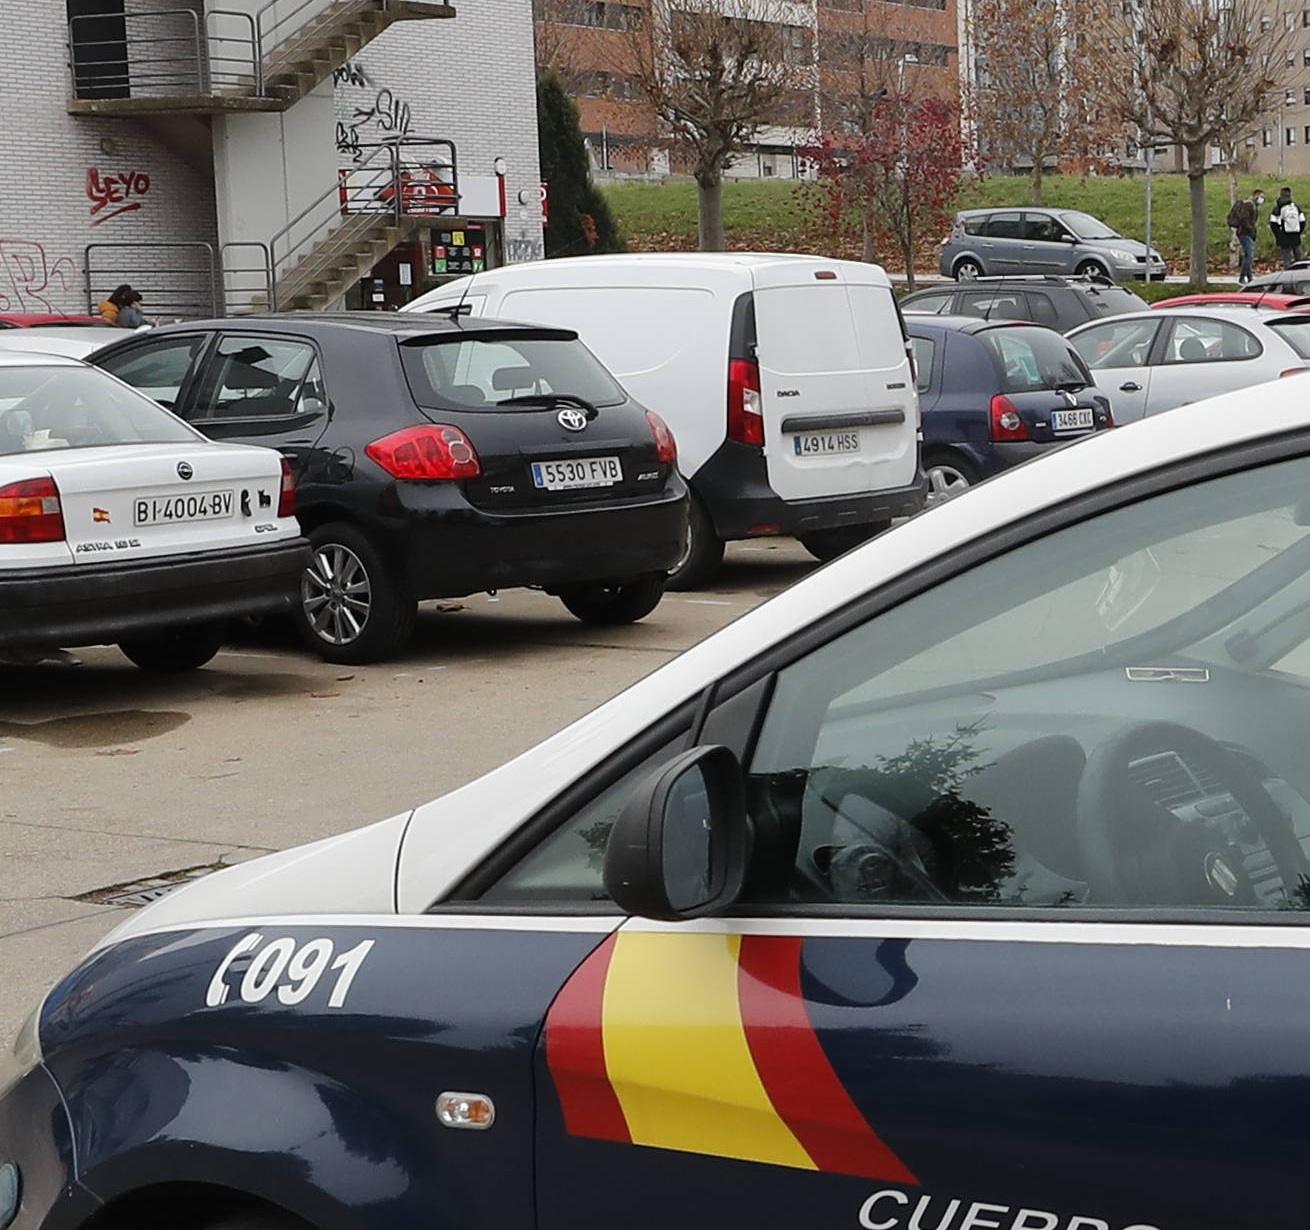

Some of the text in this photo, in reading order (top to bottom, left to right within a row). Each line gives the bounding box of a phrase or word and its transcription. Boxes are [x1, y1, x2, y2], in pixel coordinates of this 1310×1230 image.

[804, 434, 858, 452] 4914 HSS
[545, 460, 618, 483] 5530 FVB
[241, 937, 376, 1008] 091
